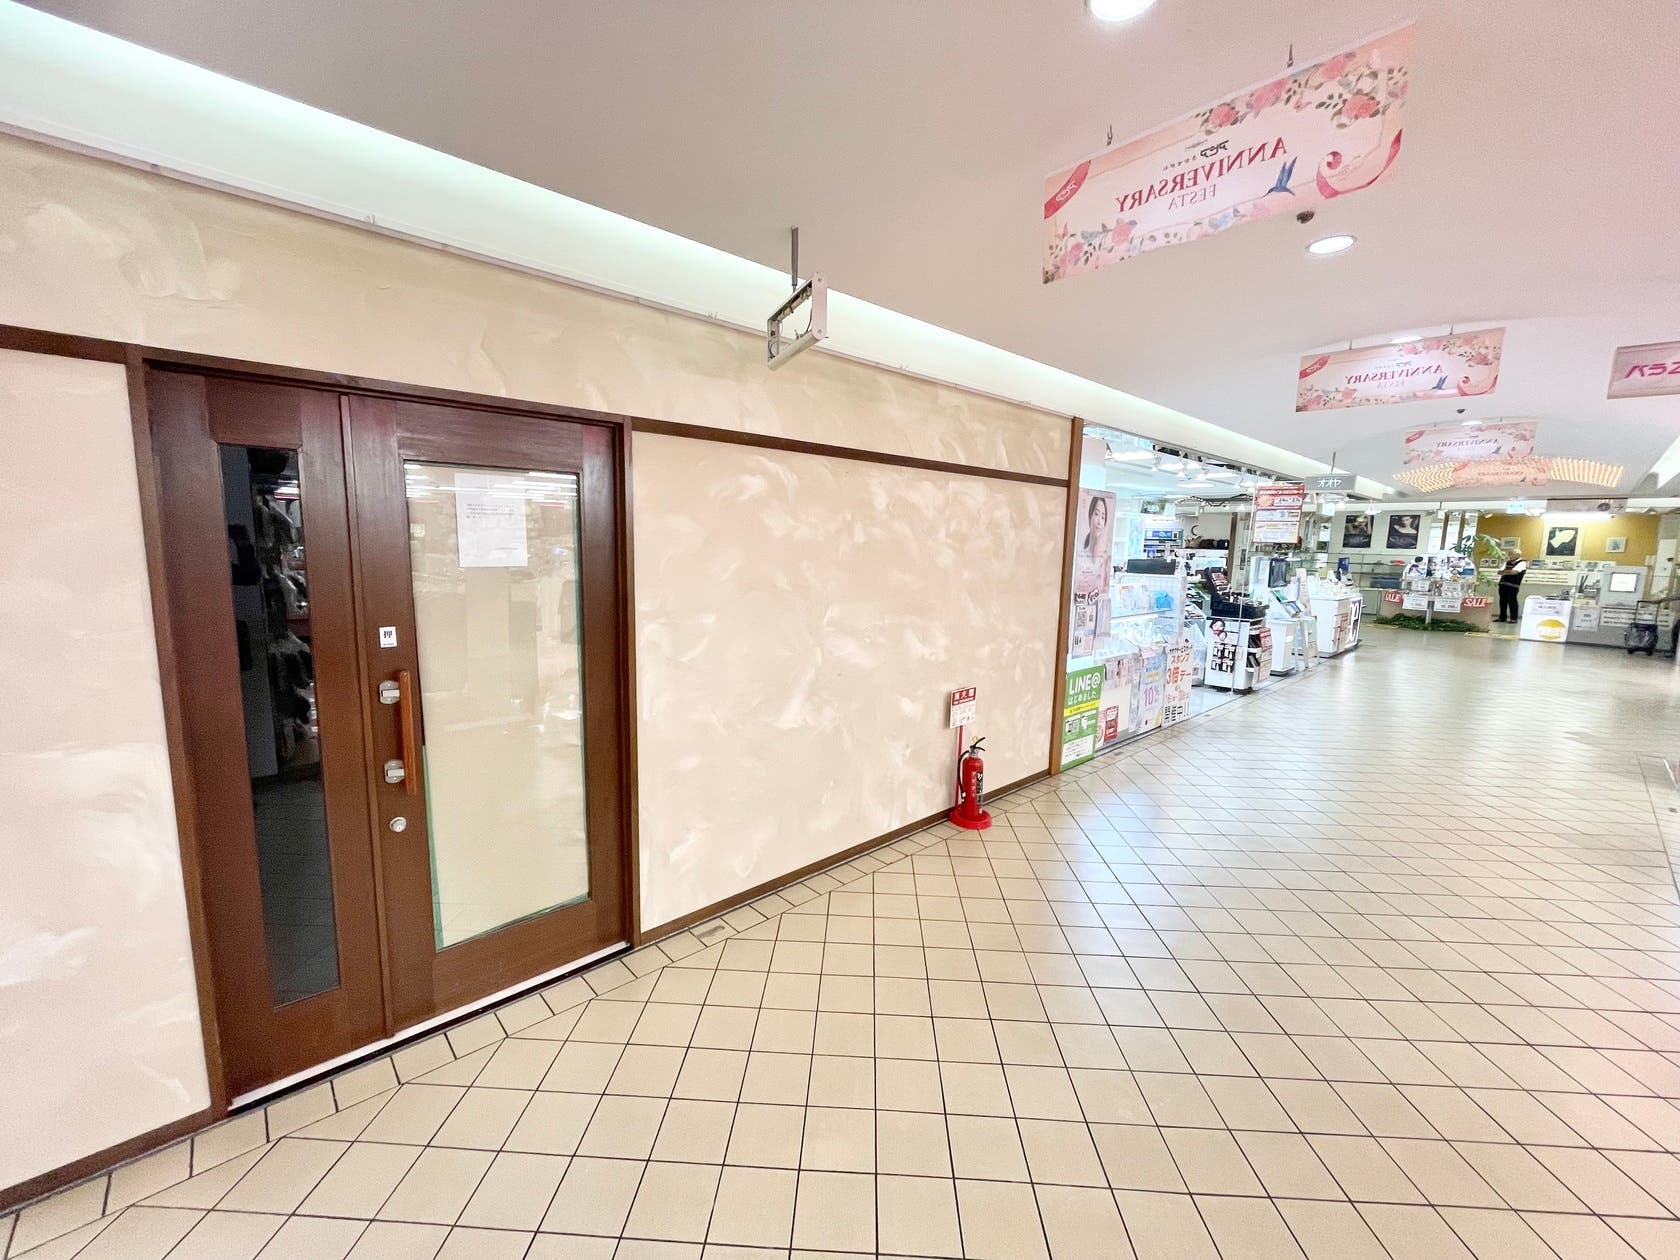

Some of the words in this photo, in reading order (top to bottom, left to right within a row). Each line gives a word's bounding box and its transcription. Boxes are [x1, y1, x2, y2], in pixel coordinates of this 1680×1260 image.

[1318, 478, 1342, 488] オオヤ
[1464, 598, 1487, 607] SALE
[1069, 672, 1101, 695] LINE@
